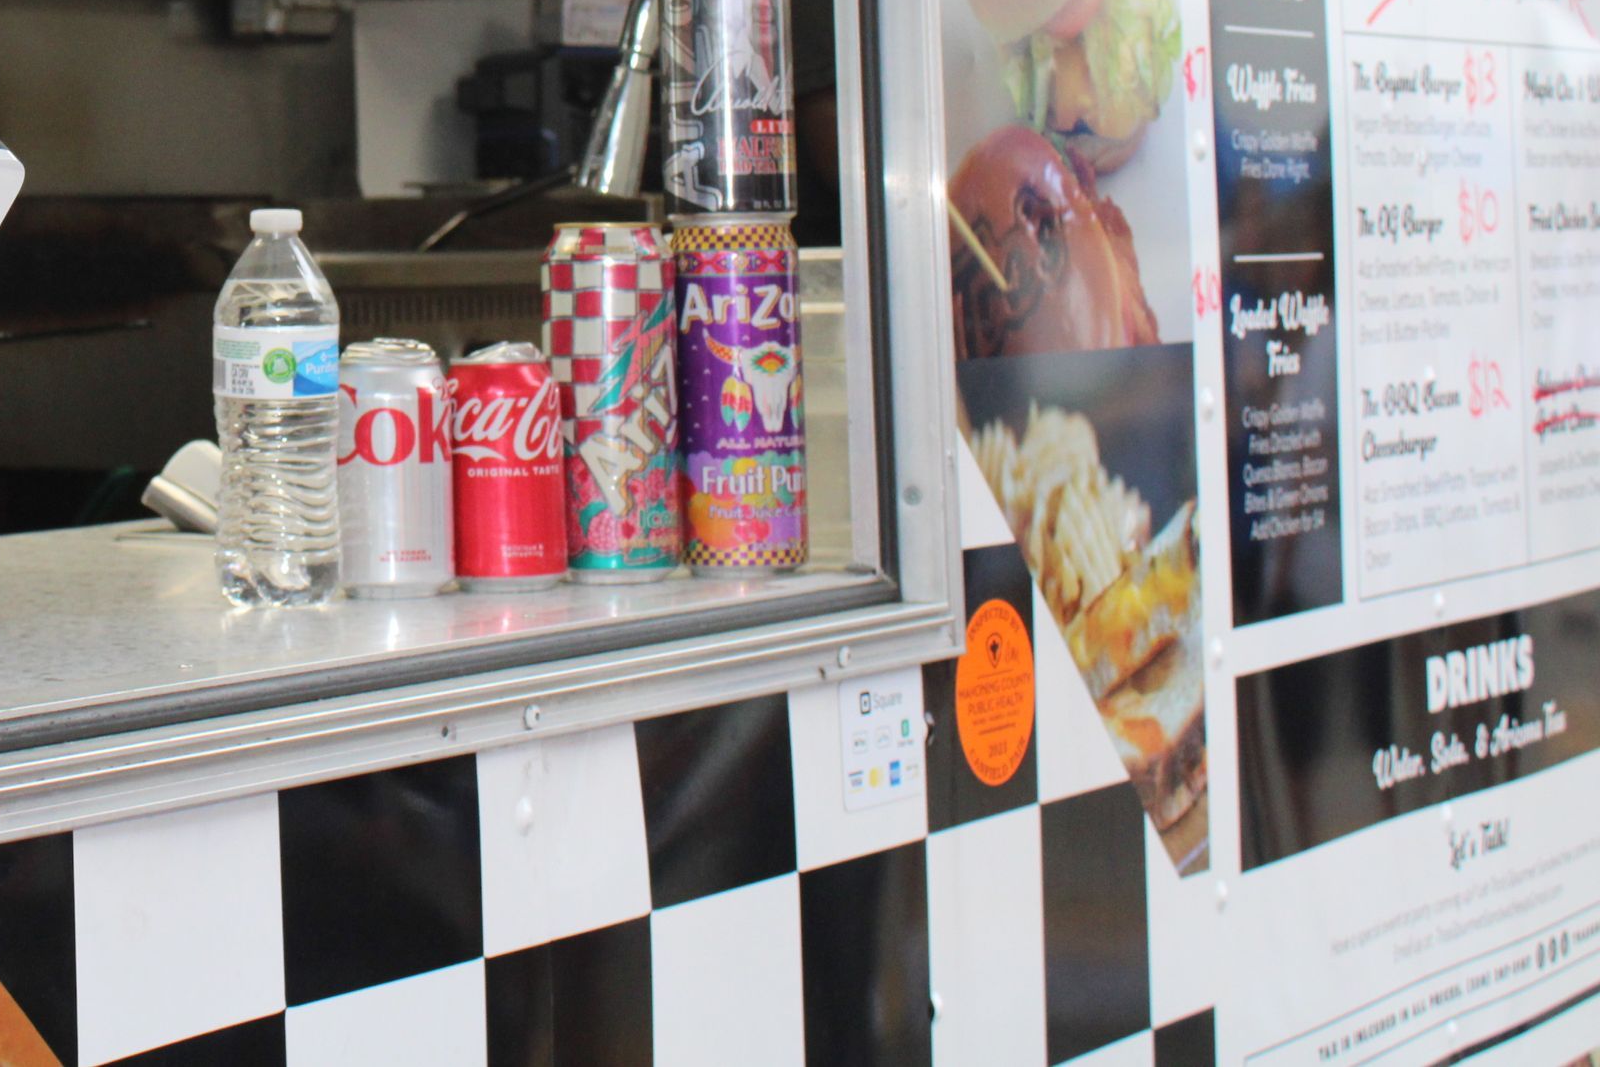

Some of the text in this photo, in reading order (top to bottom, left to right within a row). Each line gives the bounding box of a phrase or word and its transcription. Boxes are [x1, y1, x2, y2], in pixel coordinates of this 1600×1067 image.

[1226, 63, 1318, 112] Waffle Fries
[680, 282, 800, 335] AriZo
[1229, 292, 1278, 340] Loaded
[1278, 289, 1330, 336] Waffle
[1265, 340, 1301, 378] Fries
[466, 466, 529, 478] ORIGINAL
[702, 465, 764, 495] Fruit
[1425, 635, 1535, 714] DRINKS
